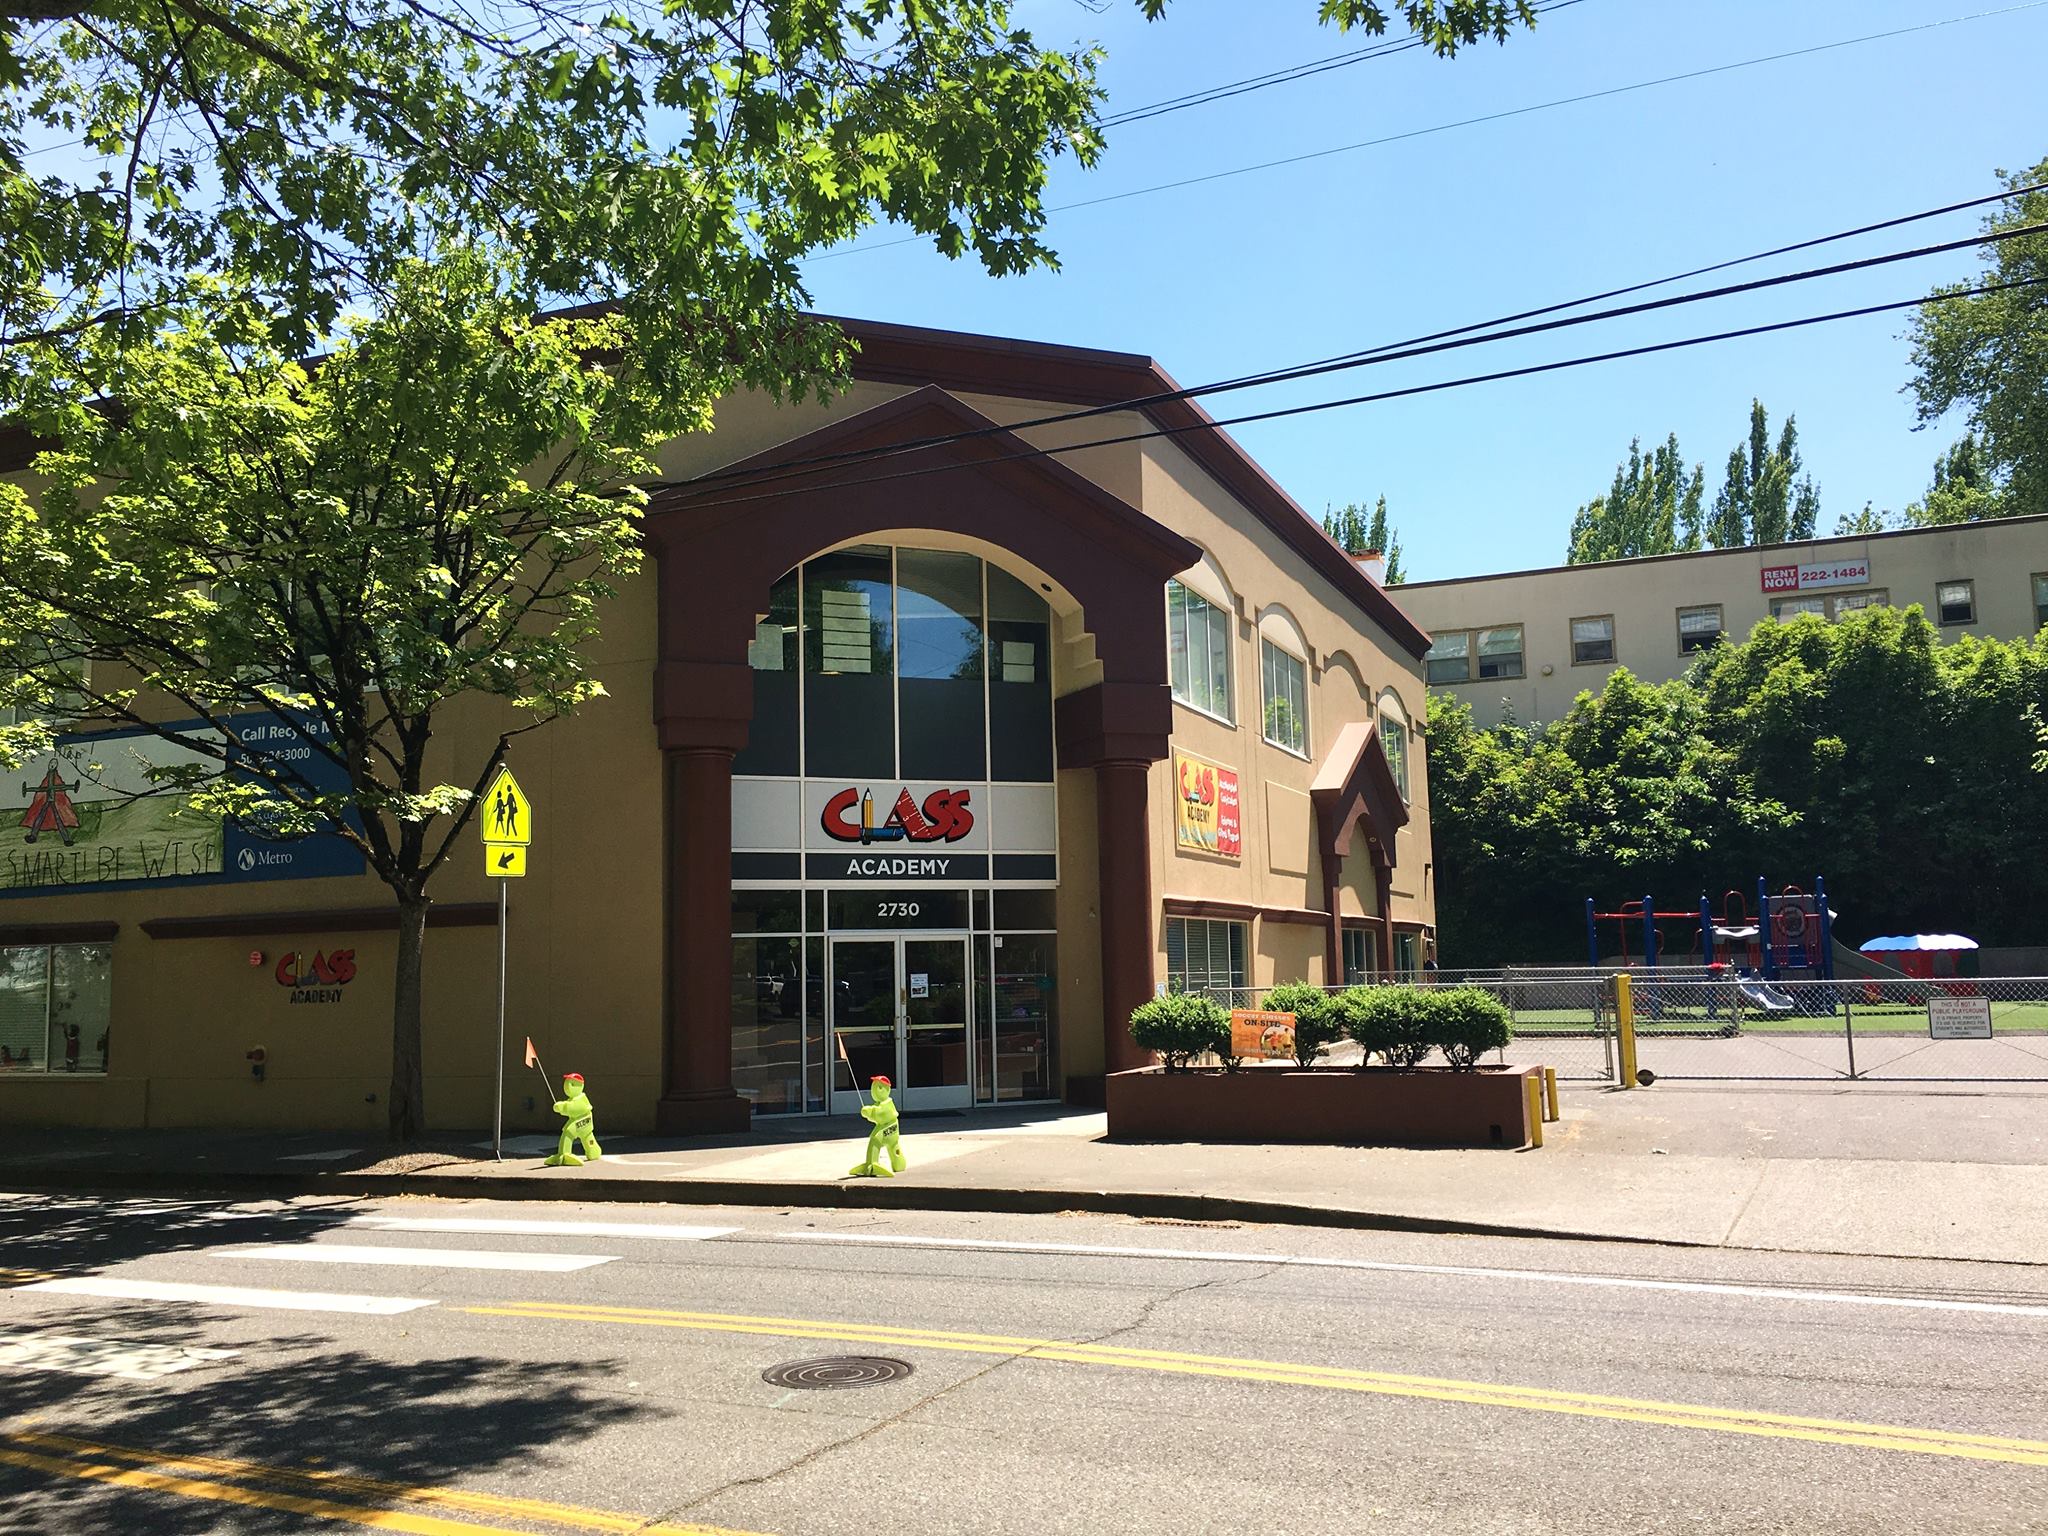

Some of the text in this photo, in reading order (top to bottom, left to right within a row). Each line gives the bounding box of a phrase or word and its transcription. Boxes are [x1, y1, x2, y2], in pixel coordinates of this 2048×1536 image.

[1764, 568, 1796, 579] RENT
[1801, 566, 1866, 581] 222-1484
[1764, 577, 1797, 588] NOW
[241, 726, 265, 741] Call
[269, 722, 318, 740] Recyle
[820, 786, 974, 845] CLASS
[1187, 804, 1210, 824] ACADEMY
[258, 851, 293, 865] Metro
[7, 849, 87, 888] SMART!
[846, 858, 950, 875] ACADEMY
[877, 902, 920, 917] 2730
[275, 949, 357, 988] CLASS
[290, 989, 343, 1004] ACADEMY
